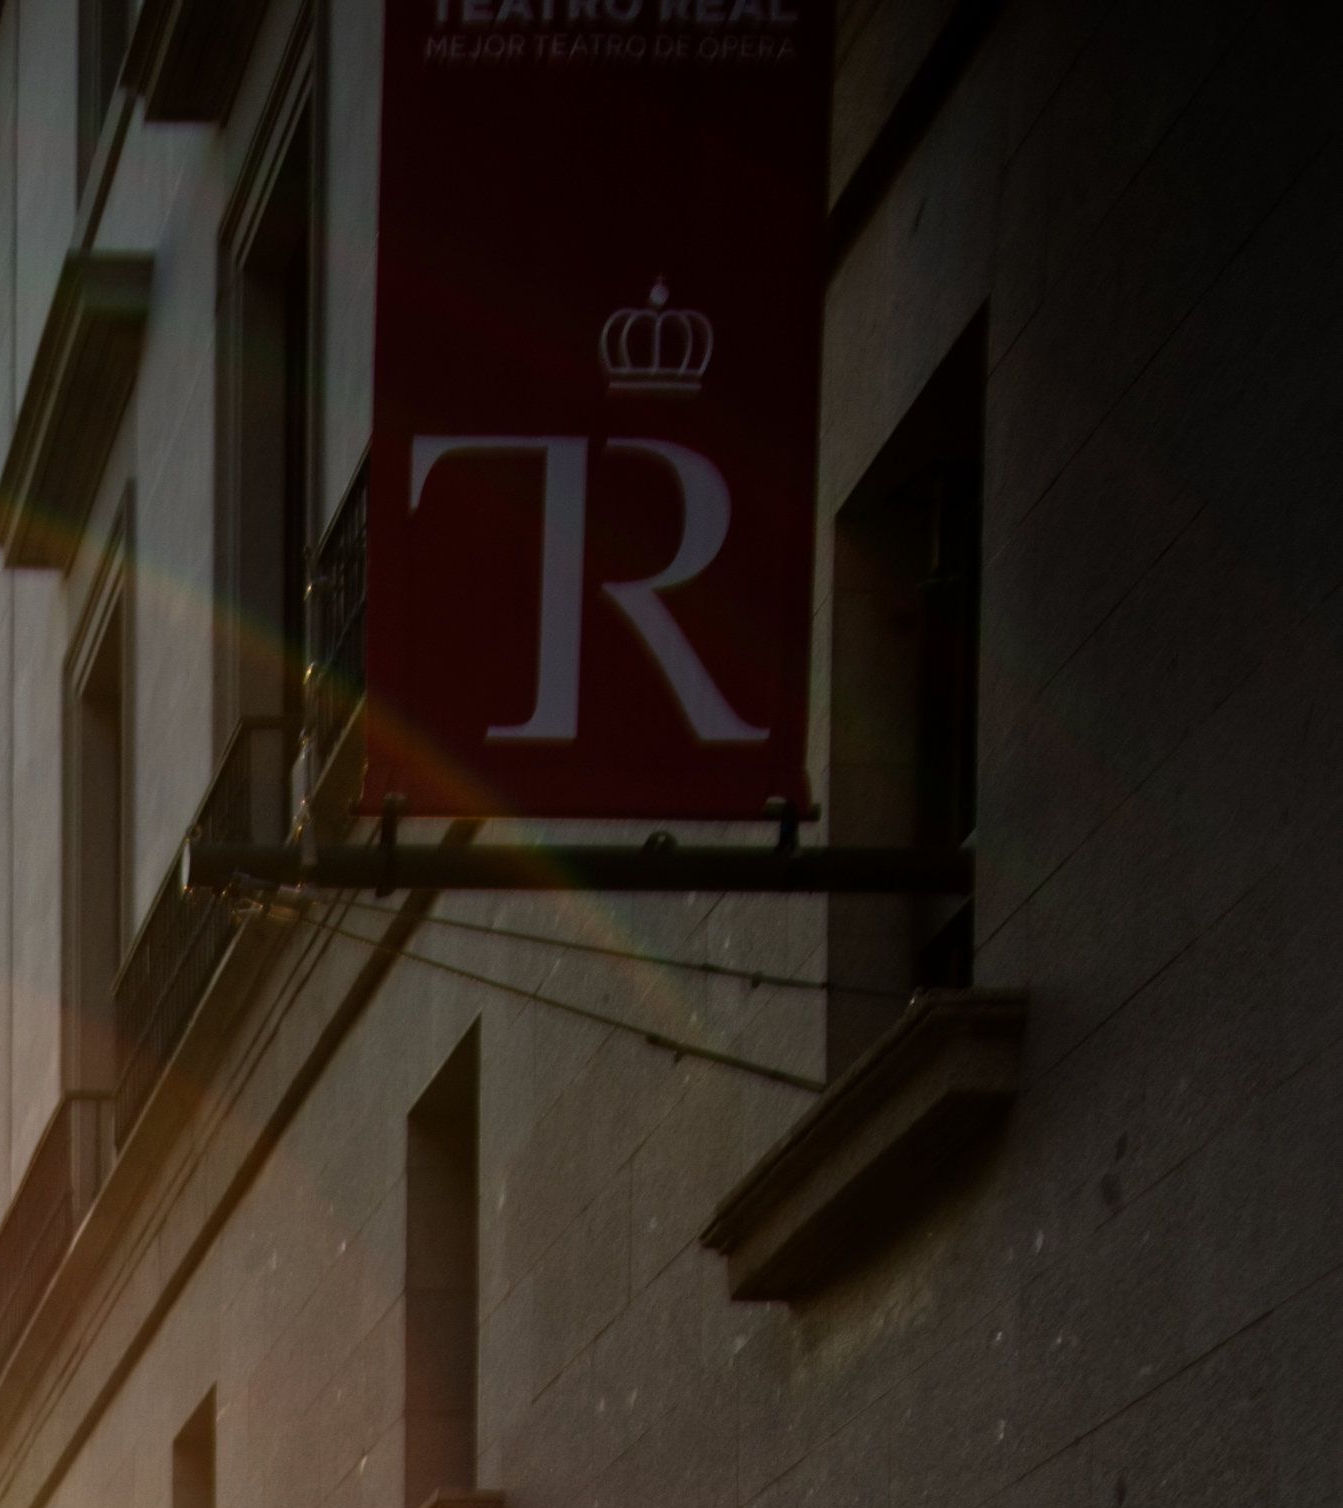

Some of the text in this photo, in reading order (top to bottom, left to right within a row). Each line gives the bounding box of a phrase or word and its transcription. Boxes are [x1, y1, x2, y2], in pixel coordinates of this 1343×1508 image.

[426, 32, 528, 61] MEJOR
[535, 32, 646, 61] TEATRO
[653, 32, 693, 60] DE
